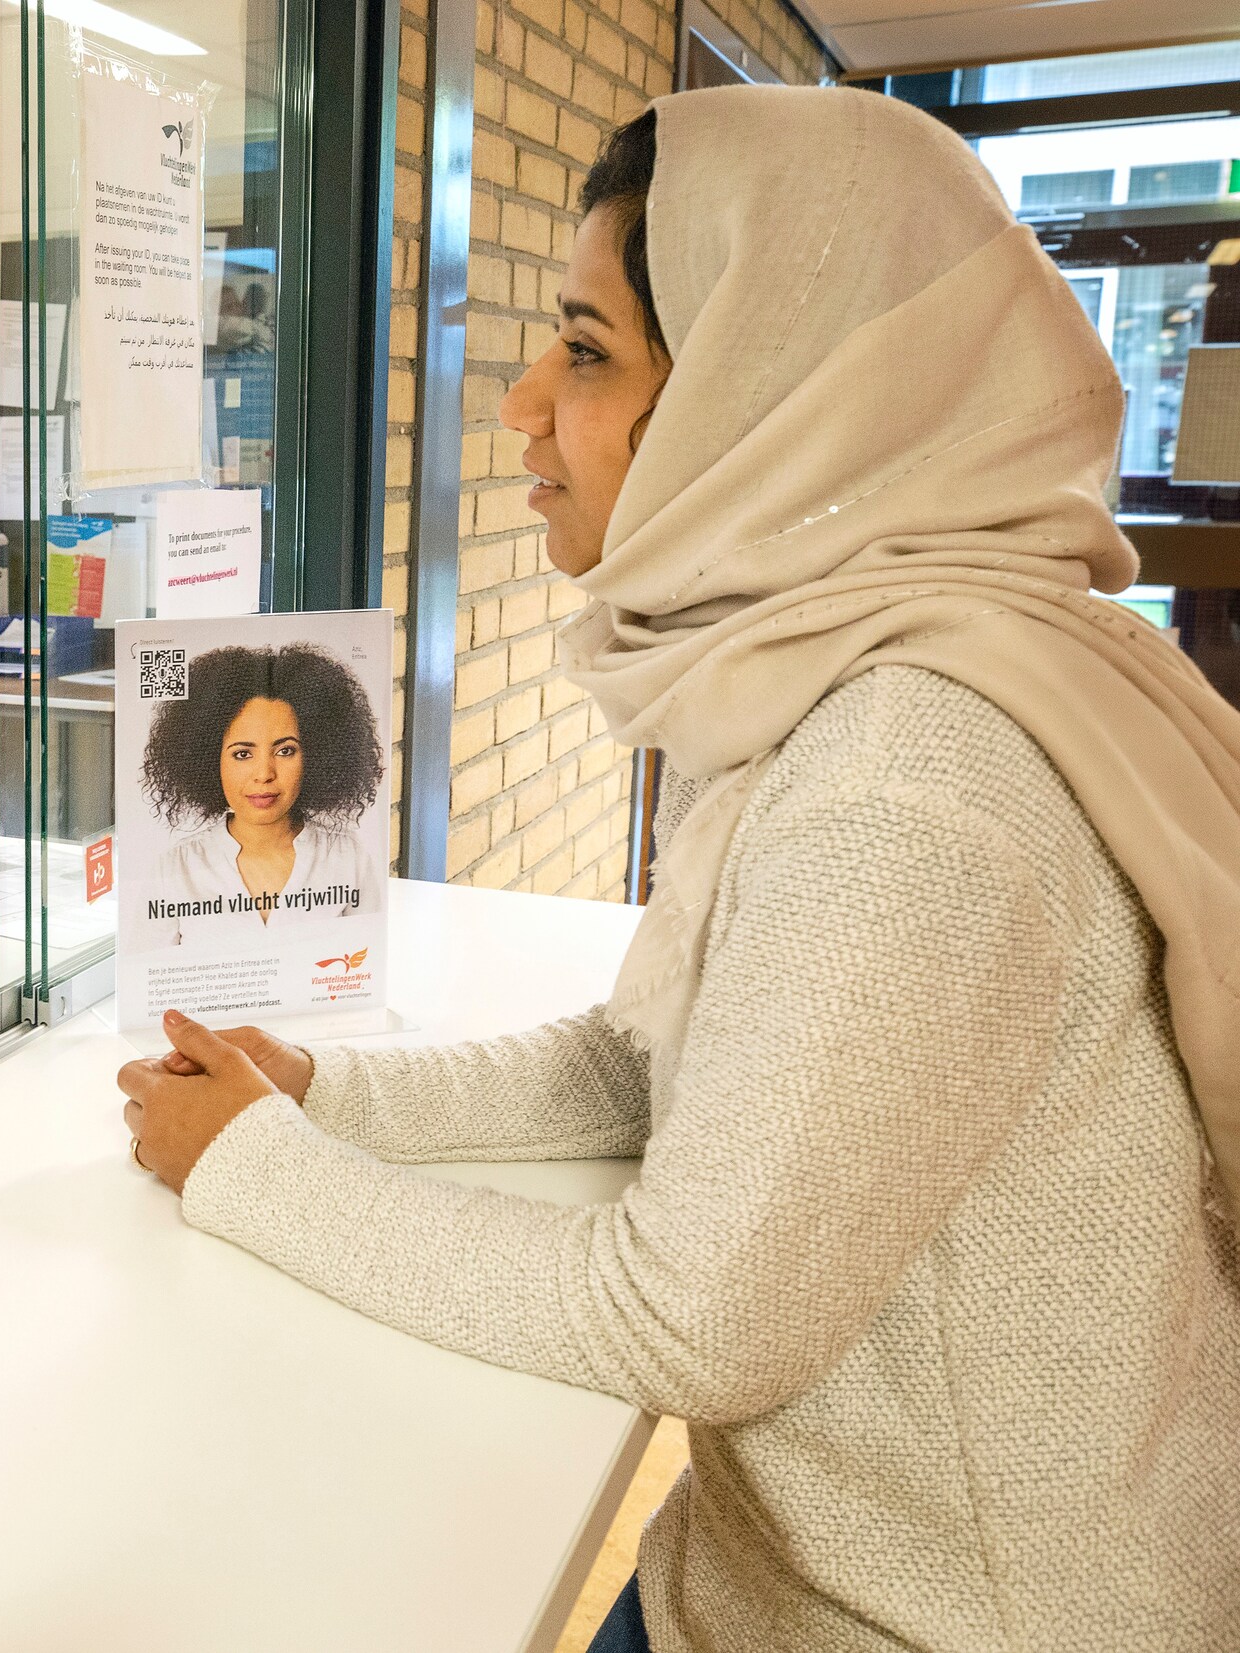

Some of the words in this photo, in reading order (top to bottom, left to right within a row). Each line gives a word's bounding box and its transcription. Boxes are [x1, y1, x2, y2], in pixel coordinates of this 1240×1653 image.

[95, 180, 105, 192] Na
[106, 182, 115, 194] het
[115, 184, 137, 199] afgeven
[137, 190, 147, 200] van
[148, 193, 156, 202] uw
[95, 196, 130, 212] plaatsnemen
[131, 203, 137, 214] in
[137, 204, 145, 215] de
[95, 212, 108, 224] dan
[108, 216, 116, 225] zo
[116, 217, 138, 231] spoedig
[138, 220, 158, 234] mogelijk
[94, 242, 110, 255] After
[110, 244, 131, 260] issuing
[131, 249, 144, 260] your
[152, 252, 161, 263] you
[94, 258, 101, 269] in
[101, 259, 111, 270] the
[112, 260, 133, 275] waiting
[148, 264, 158, 276] You
[94, 275, 110, 285] soon
[110, 277, 118, 286] as
[168, 533, 175, 543] To
[175, 532, 190, 545] print
[191, 531, 217, 541] documents
[168, 550, 177, 561] you
[178, 548, 189, 557] can
[190, 545, 203, 556] send
[210, 542, 221, 553] email
[148, 895, 223, 920] Niemand
[228, 892, 280, 913] vlucht
[284, 885, 361, 911] vrijwillig
[148, 968, 160, 976] Ben
[161, 968, 167, 976] je
[168, 965, 196, 974] benieuwd
[197, 963, 220, 971] waarom
[148, 978, 170, 987] vrijheid
[184, 974, 204, 983] leven?
[205, 973, 217, 981] Hoe
[311, 972, 372, 985] VluchtelingenWerk
[172, 984, 205, 995] ontsnapte?
[257, 979, 269, 987] zich
[328, 982, 361, 992] Nederland
[181, 996, 198, 1005] veilig
[199, 993, 223, 1003] voelde?
[231, 990, 258, 999] vertellen
